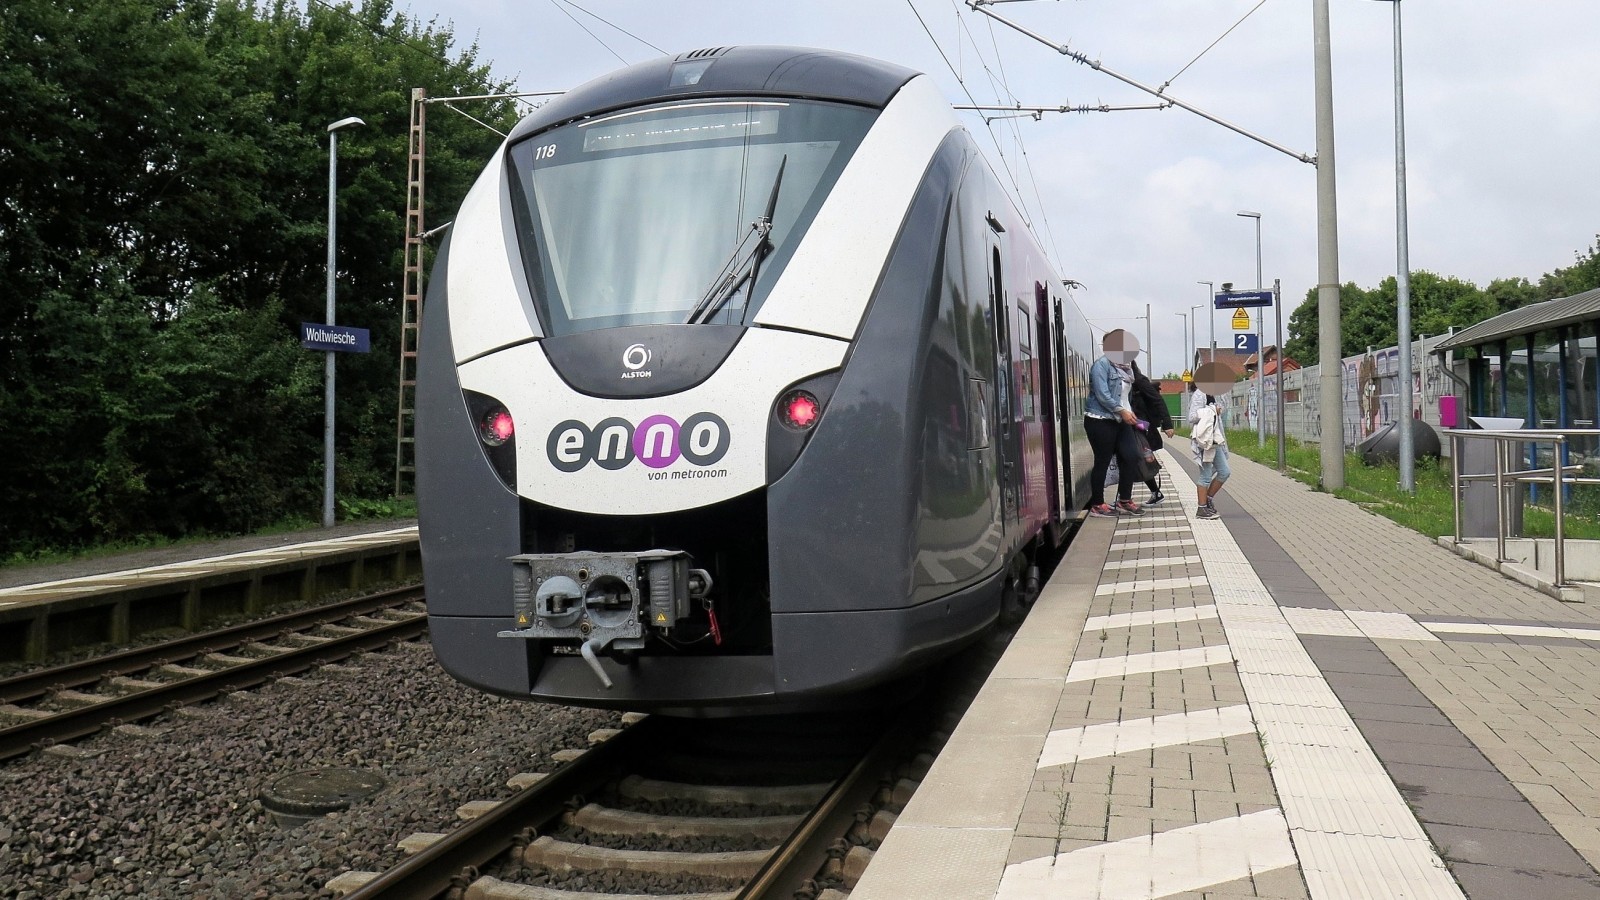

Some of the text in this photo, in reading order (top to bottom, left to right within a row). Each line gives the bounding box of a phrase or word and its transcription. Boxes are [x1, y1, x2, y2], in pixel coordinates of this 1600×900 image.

[535, 144, 557, 161] 118
[306, 327, 356, 345] Woltwiesche
[1237, 334, 1248, 349] 2
[621, 370, 652, 379] ALSTOM
[554, 419, 722, 465] enno
[648, 469, 728, 481] von metronom
